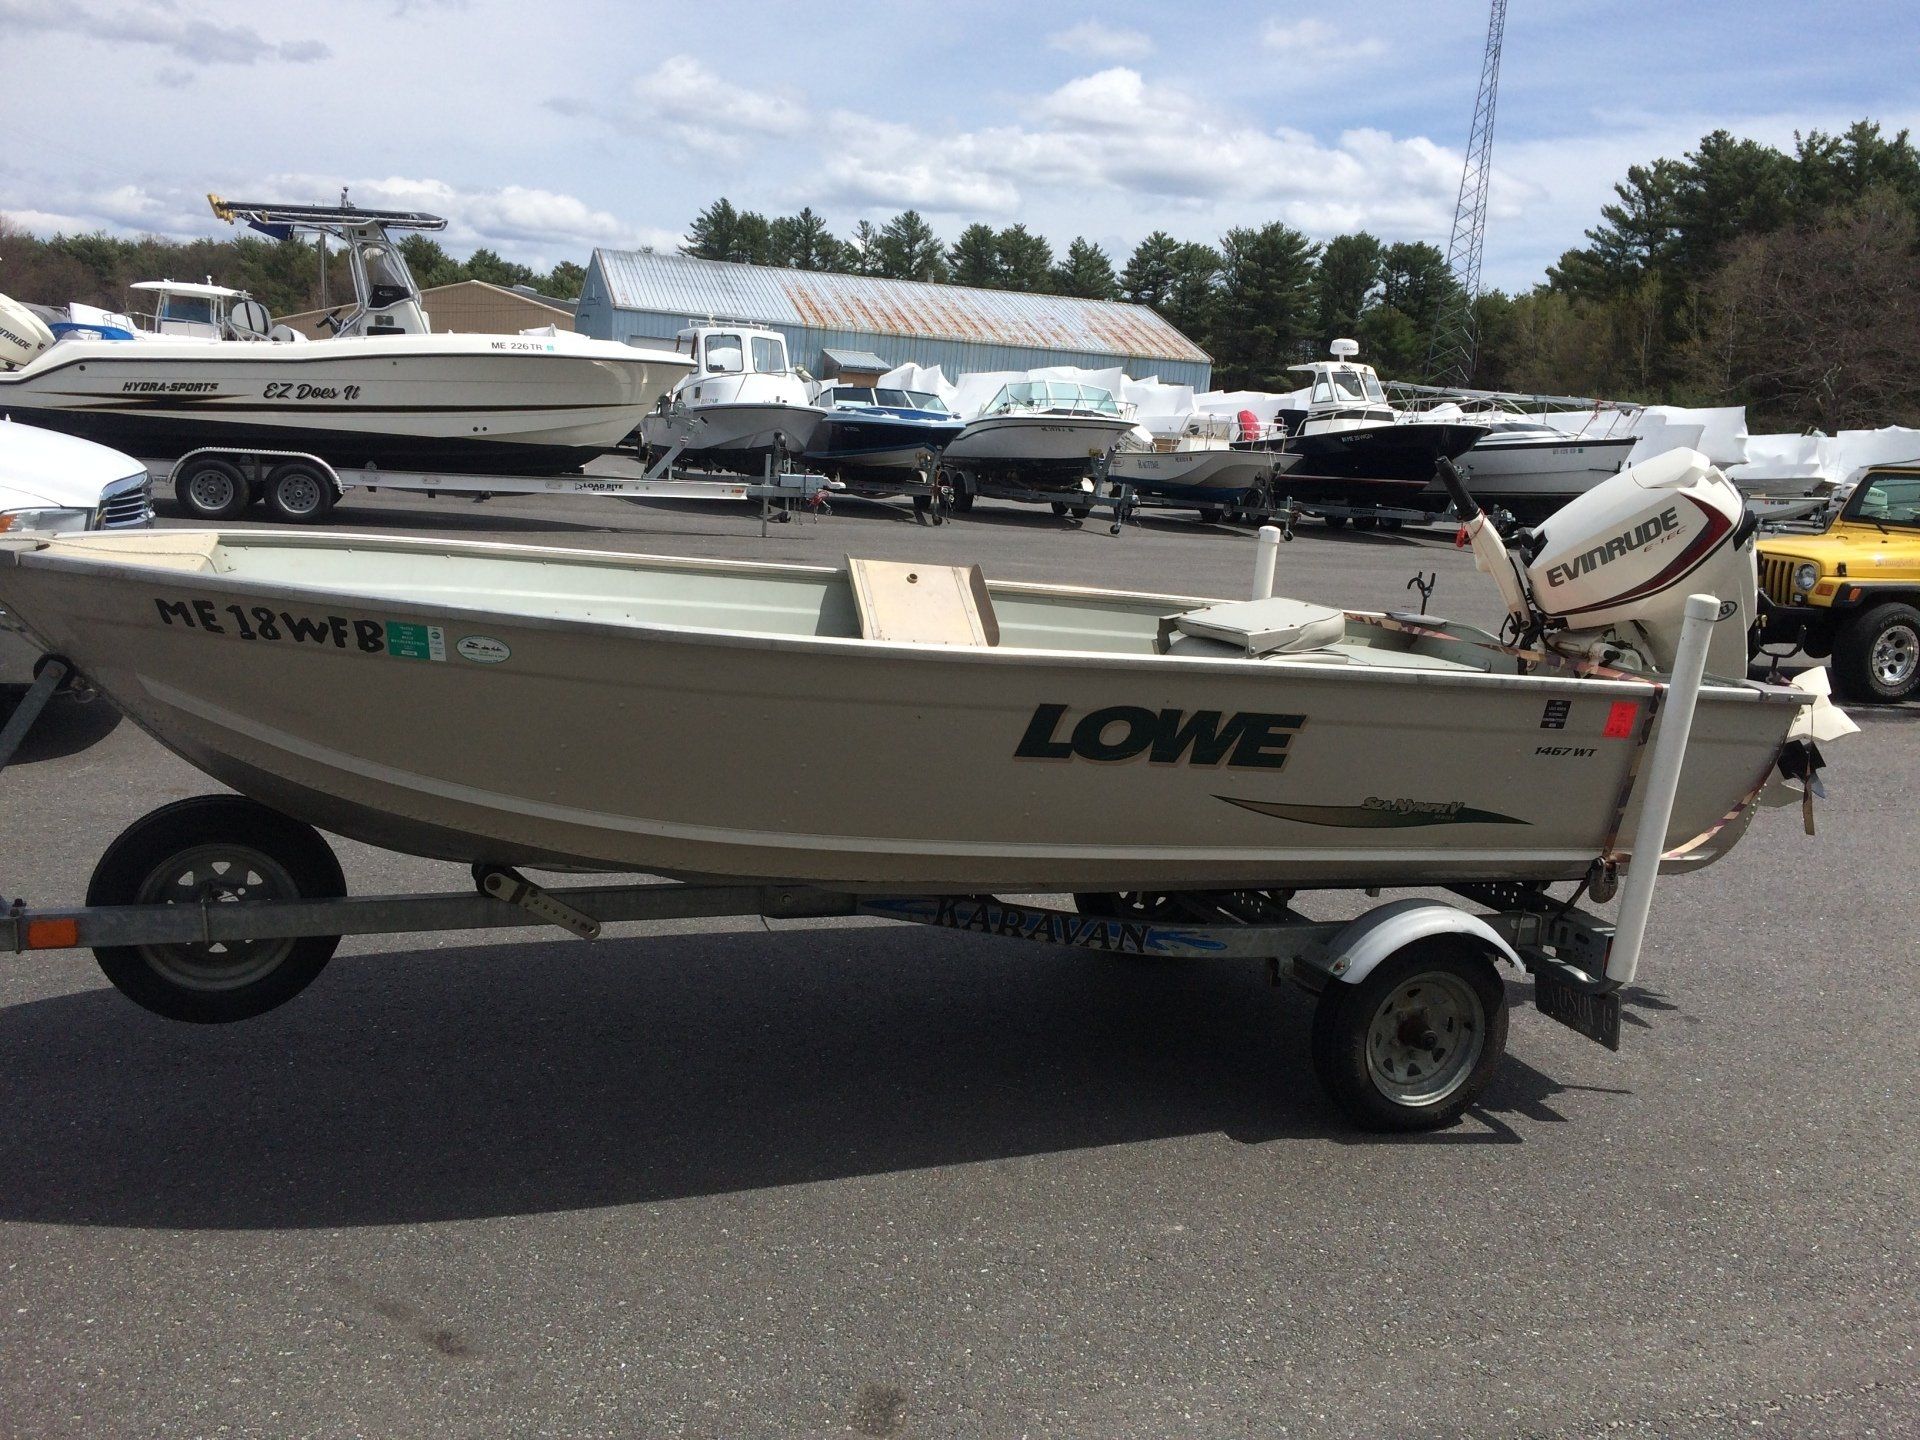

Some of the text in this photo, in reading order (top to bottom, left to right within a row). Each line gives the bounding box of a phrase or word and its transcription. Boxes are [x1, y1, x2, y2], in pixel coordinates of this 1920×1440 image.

[491, 342, 507, 350] ME
[122, 381, 219, 392] HYDRA-SPORTS
[263, 382, 361, 401] EZ Does It
[1546, 506, 1679, 588] EVINRUDE
[1643, 524, 1687, 554] E-TEC
[153, 598, 226, 635] ME
[1012, 703, 1308, 773] LOWE
[1534, 746, 1598, 758] 1467 WT
[934, 900, 1152, 954] KARAVAN
